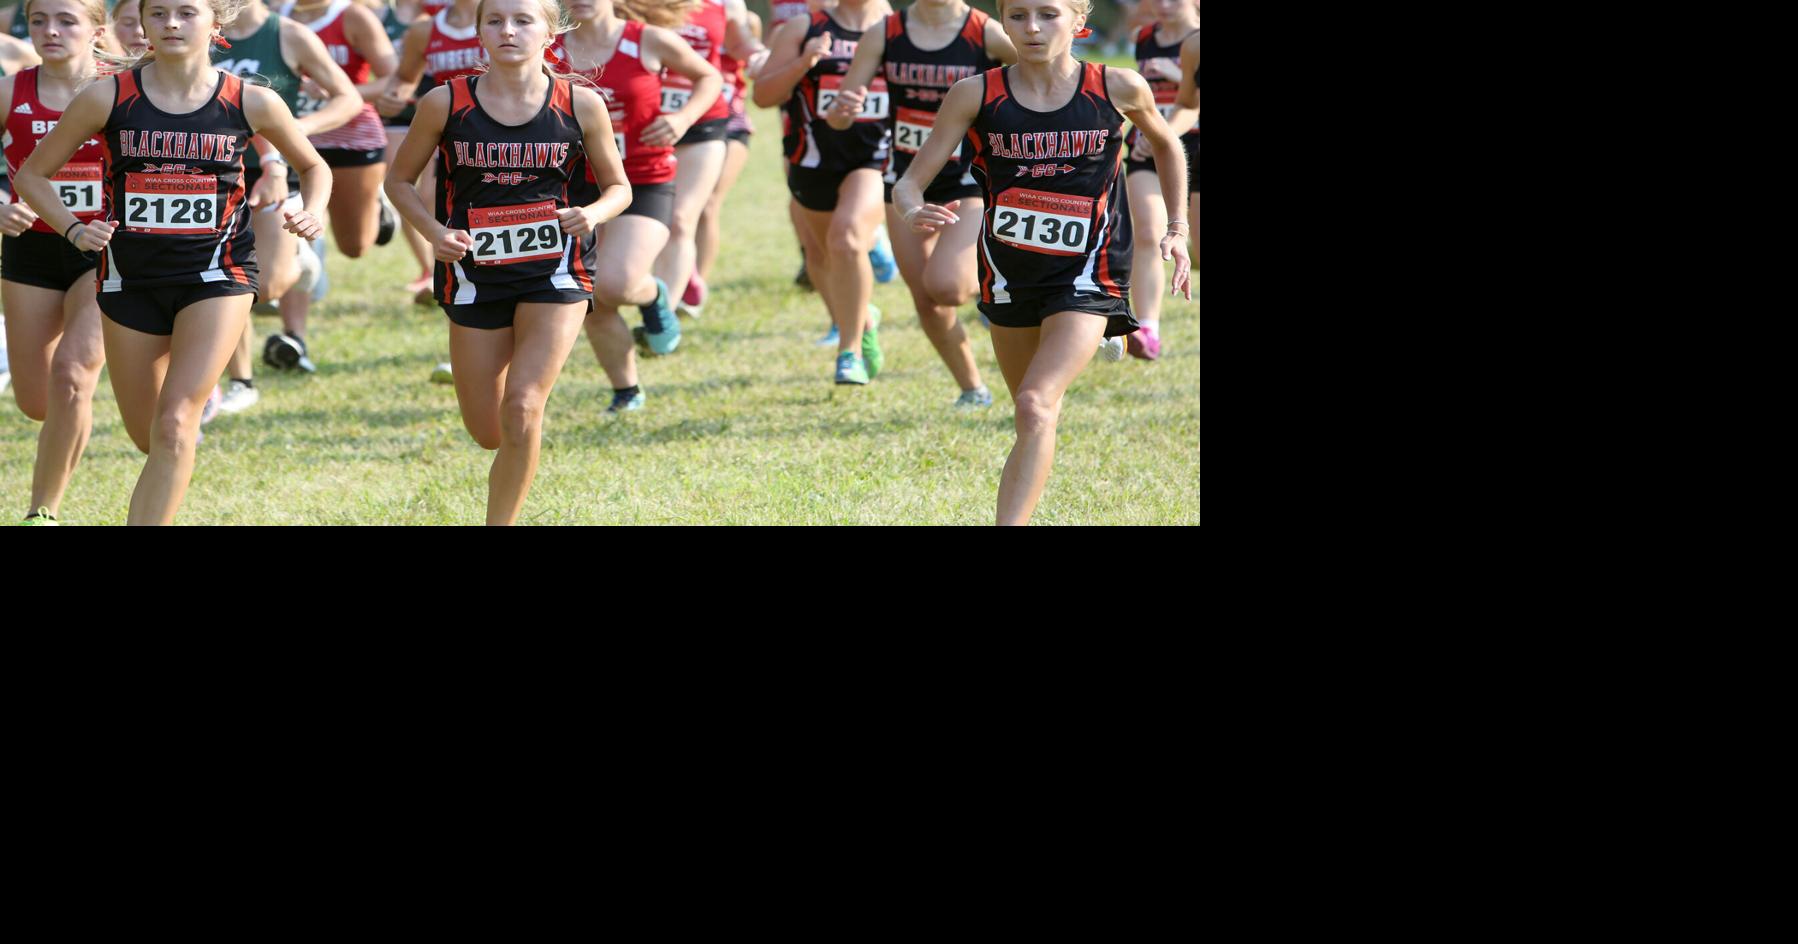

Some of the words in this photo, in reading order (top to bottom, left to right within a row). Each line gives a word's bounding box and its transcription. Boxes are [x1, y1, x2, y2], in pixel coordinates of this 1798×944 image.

[120, 129, 237, 162] BLACKHAWKS
[898, 126, 931, 147] 21
[988, 129, 1109, 160] BLACKHAWKS
[454, 141, 570, 168] BLACKHAWKS
[60, 184, 93, 207] 51
[144, 183, 216, 191] SECTIONALS
[129, 197, 213, 224] 2128
[526, 204, 554, 213] COUNTRY
[1017, 197, 1090, 214] SECTIONALS
[1037, 194, 1060, 202] CROSS
[1060, 198, 1092, 206] COUNTRY
[474, 224, 558, 256] 2129
[996, 211, 1085, 247] 2130
